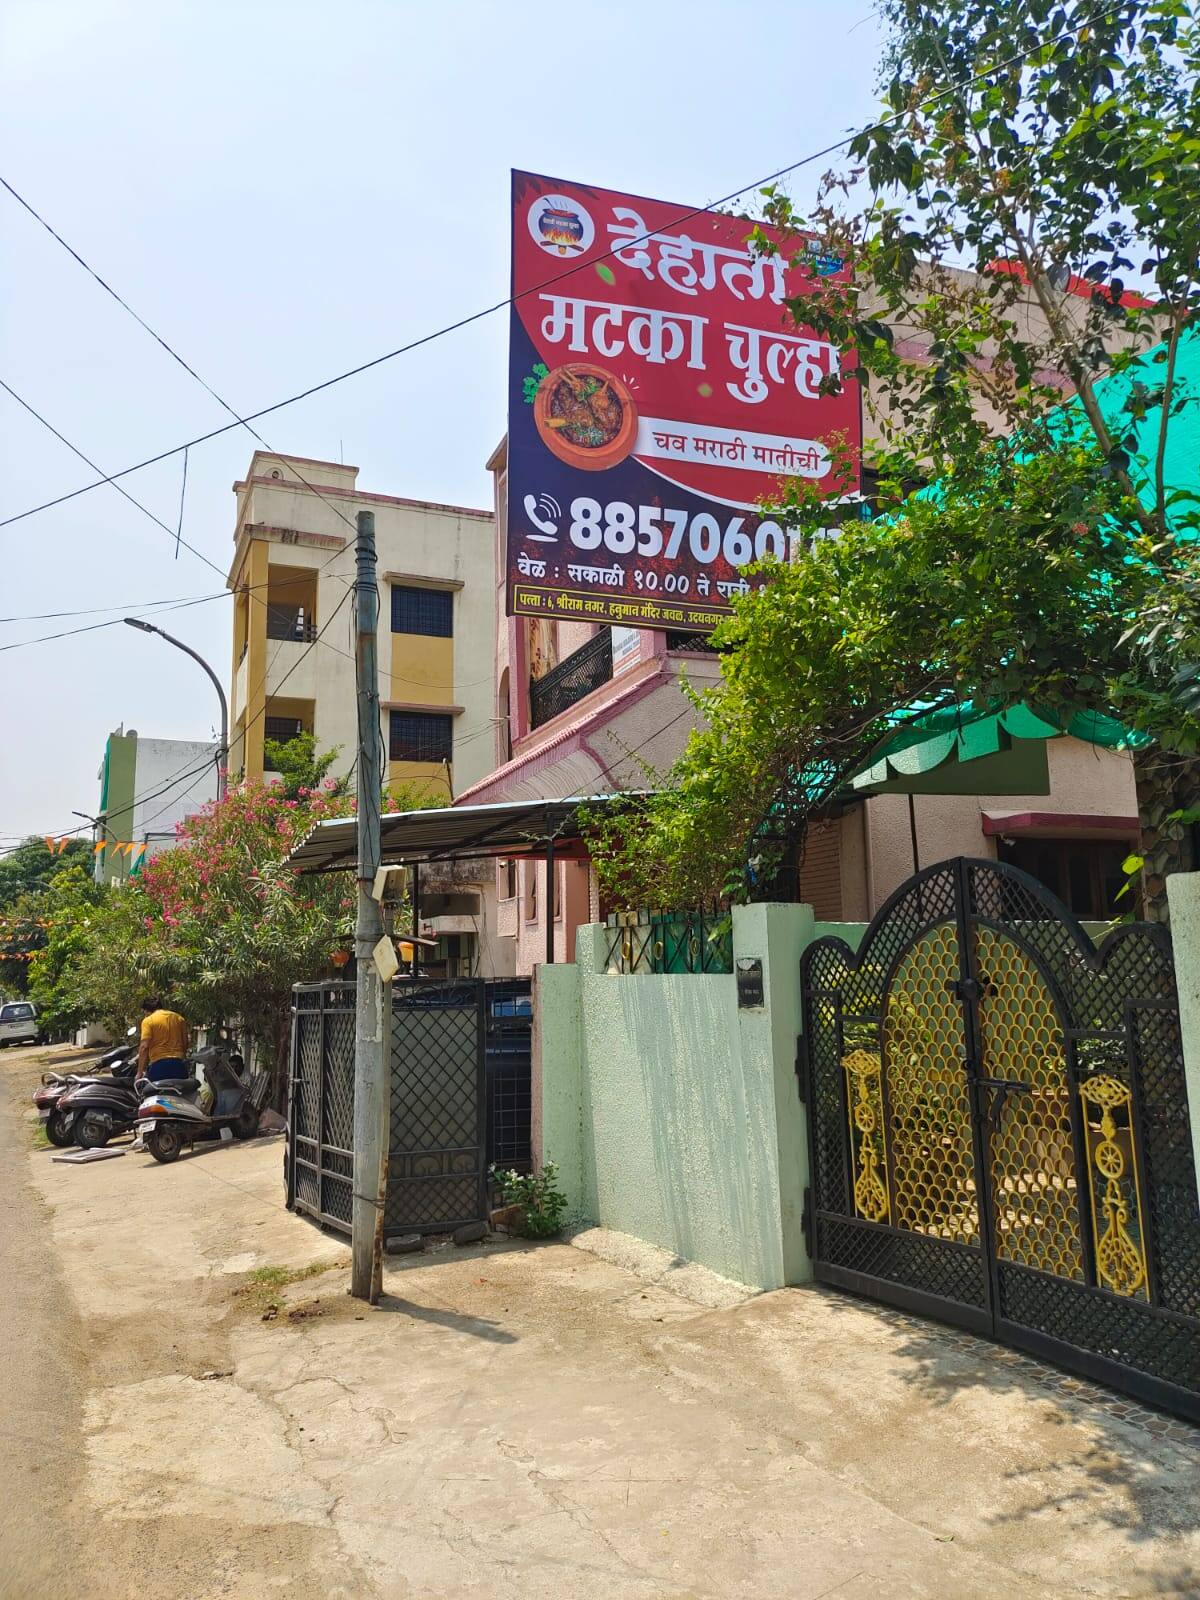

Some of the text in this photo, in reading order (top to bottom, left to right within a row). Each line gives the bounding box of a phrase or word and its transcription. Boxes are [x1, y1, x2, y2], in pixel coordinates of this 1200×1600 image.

[607, 206, 789, 306] देहाती
[538, 293, 844, 404] मटका चुल्हा
[652, 431, 821, 471] चव मराठी मातीची
[569, 497, 843, 571] 88570601
[516, 551, 547, 578] वेळ
[567, 563, 626, 587] सकाळी
[696, 572, 710, 597] ते
[556, 593, 583, 612] श्रीराम
[609, 602, 639, 619] हनुमान
